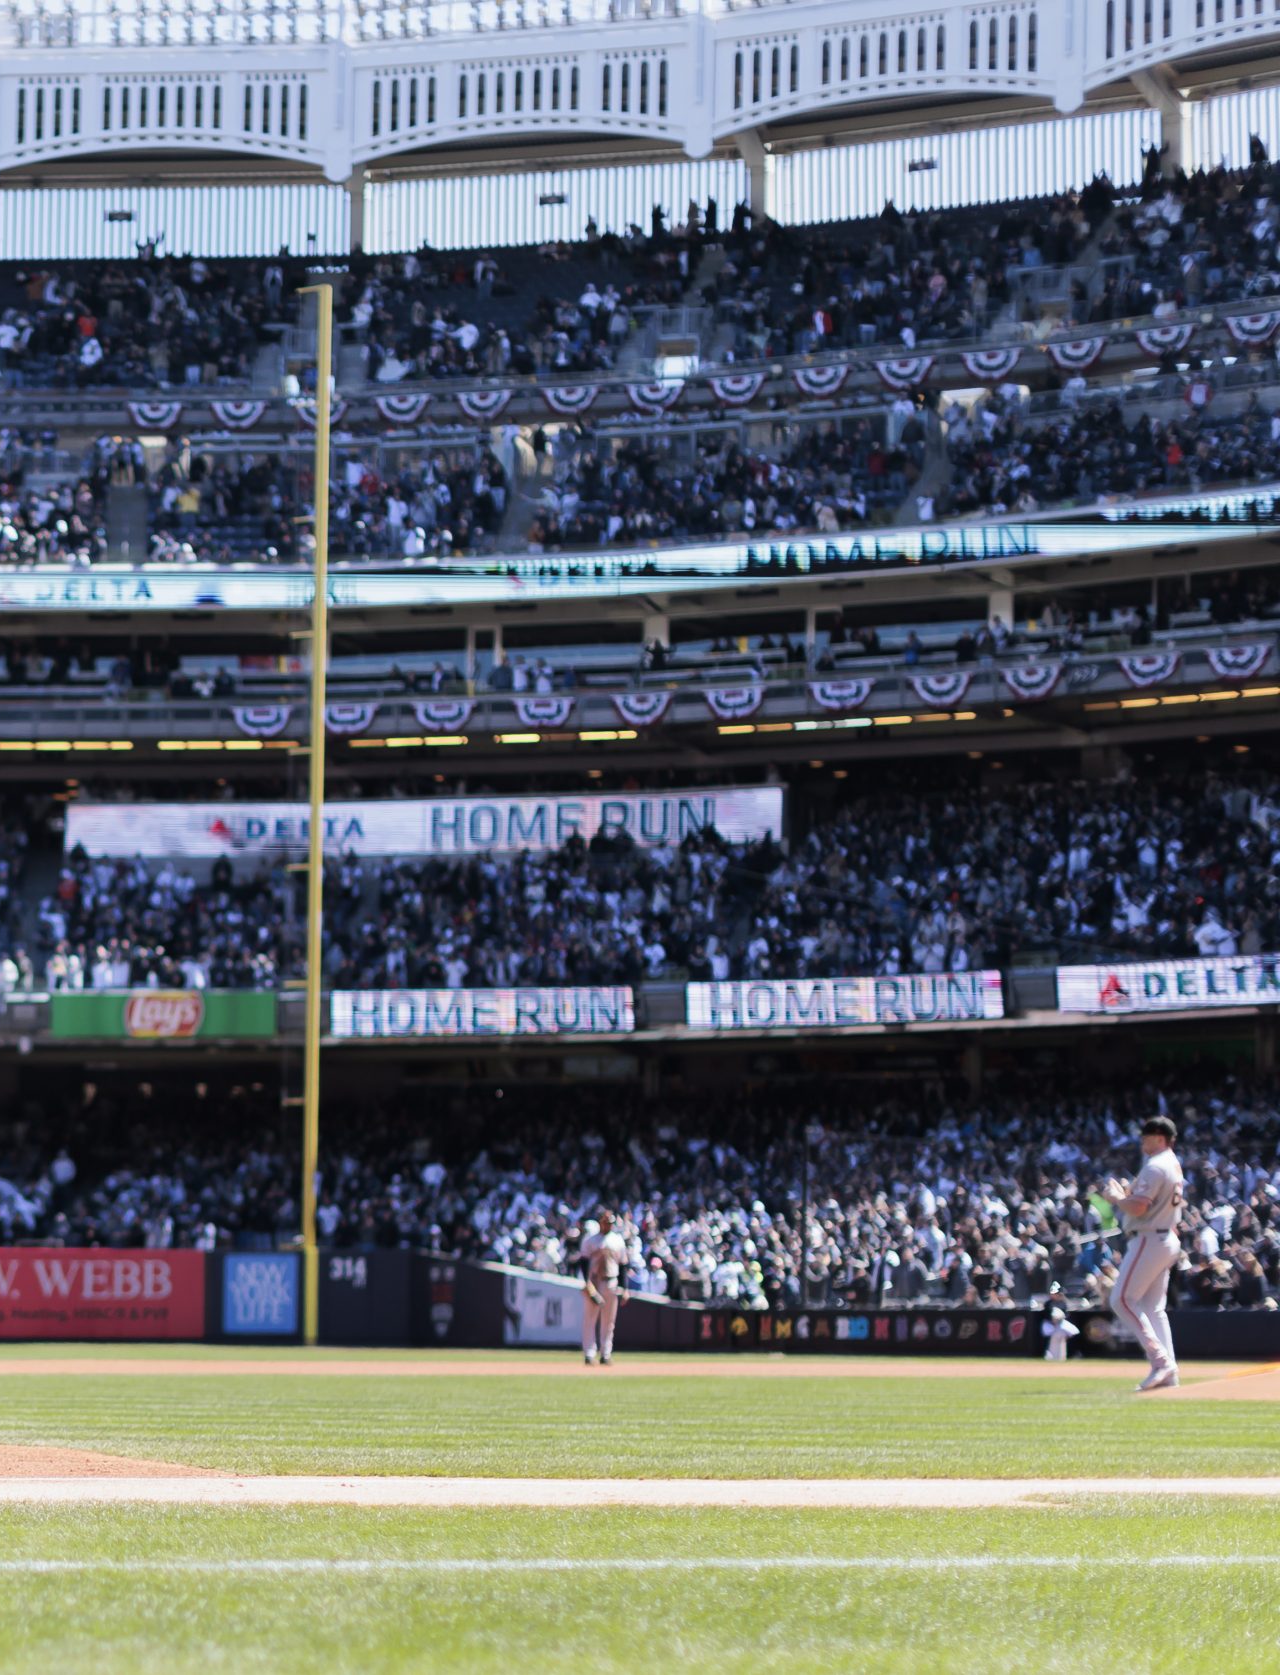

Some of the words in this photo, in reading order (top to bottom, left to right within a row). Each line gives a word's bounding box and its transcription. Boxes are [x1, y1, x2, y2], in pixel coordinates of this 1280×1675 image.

[432, 802, 586, 848] HOME
[351, 991, 505, 1034] HOME
[516, 986, 628, 1033] RUN
[711, 980, 861, 1028] HOME
[874, 974, 984, 1022] RUN
[33, 1258, 173, 1300] WEBB
[230, 1281, 291, 1304] YORK
[236, 1262, 287, 1283] NEW
[236, 1302, 282, 1324] LIFE
